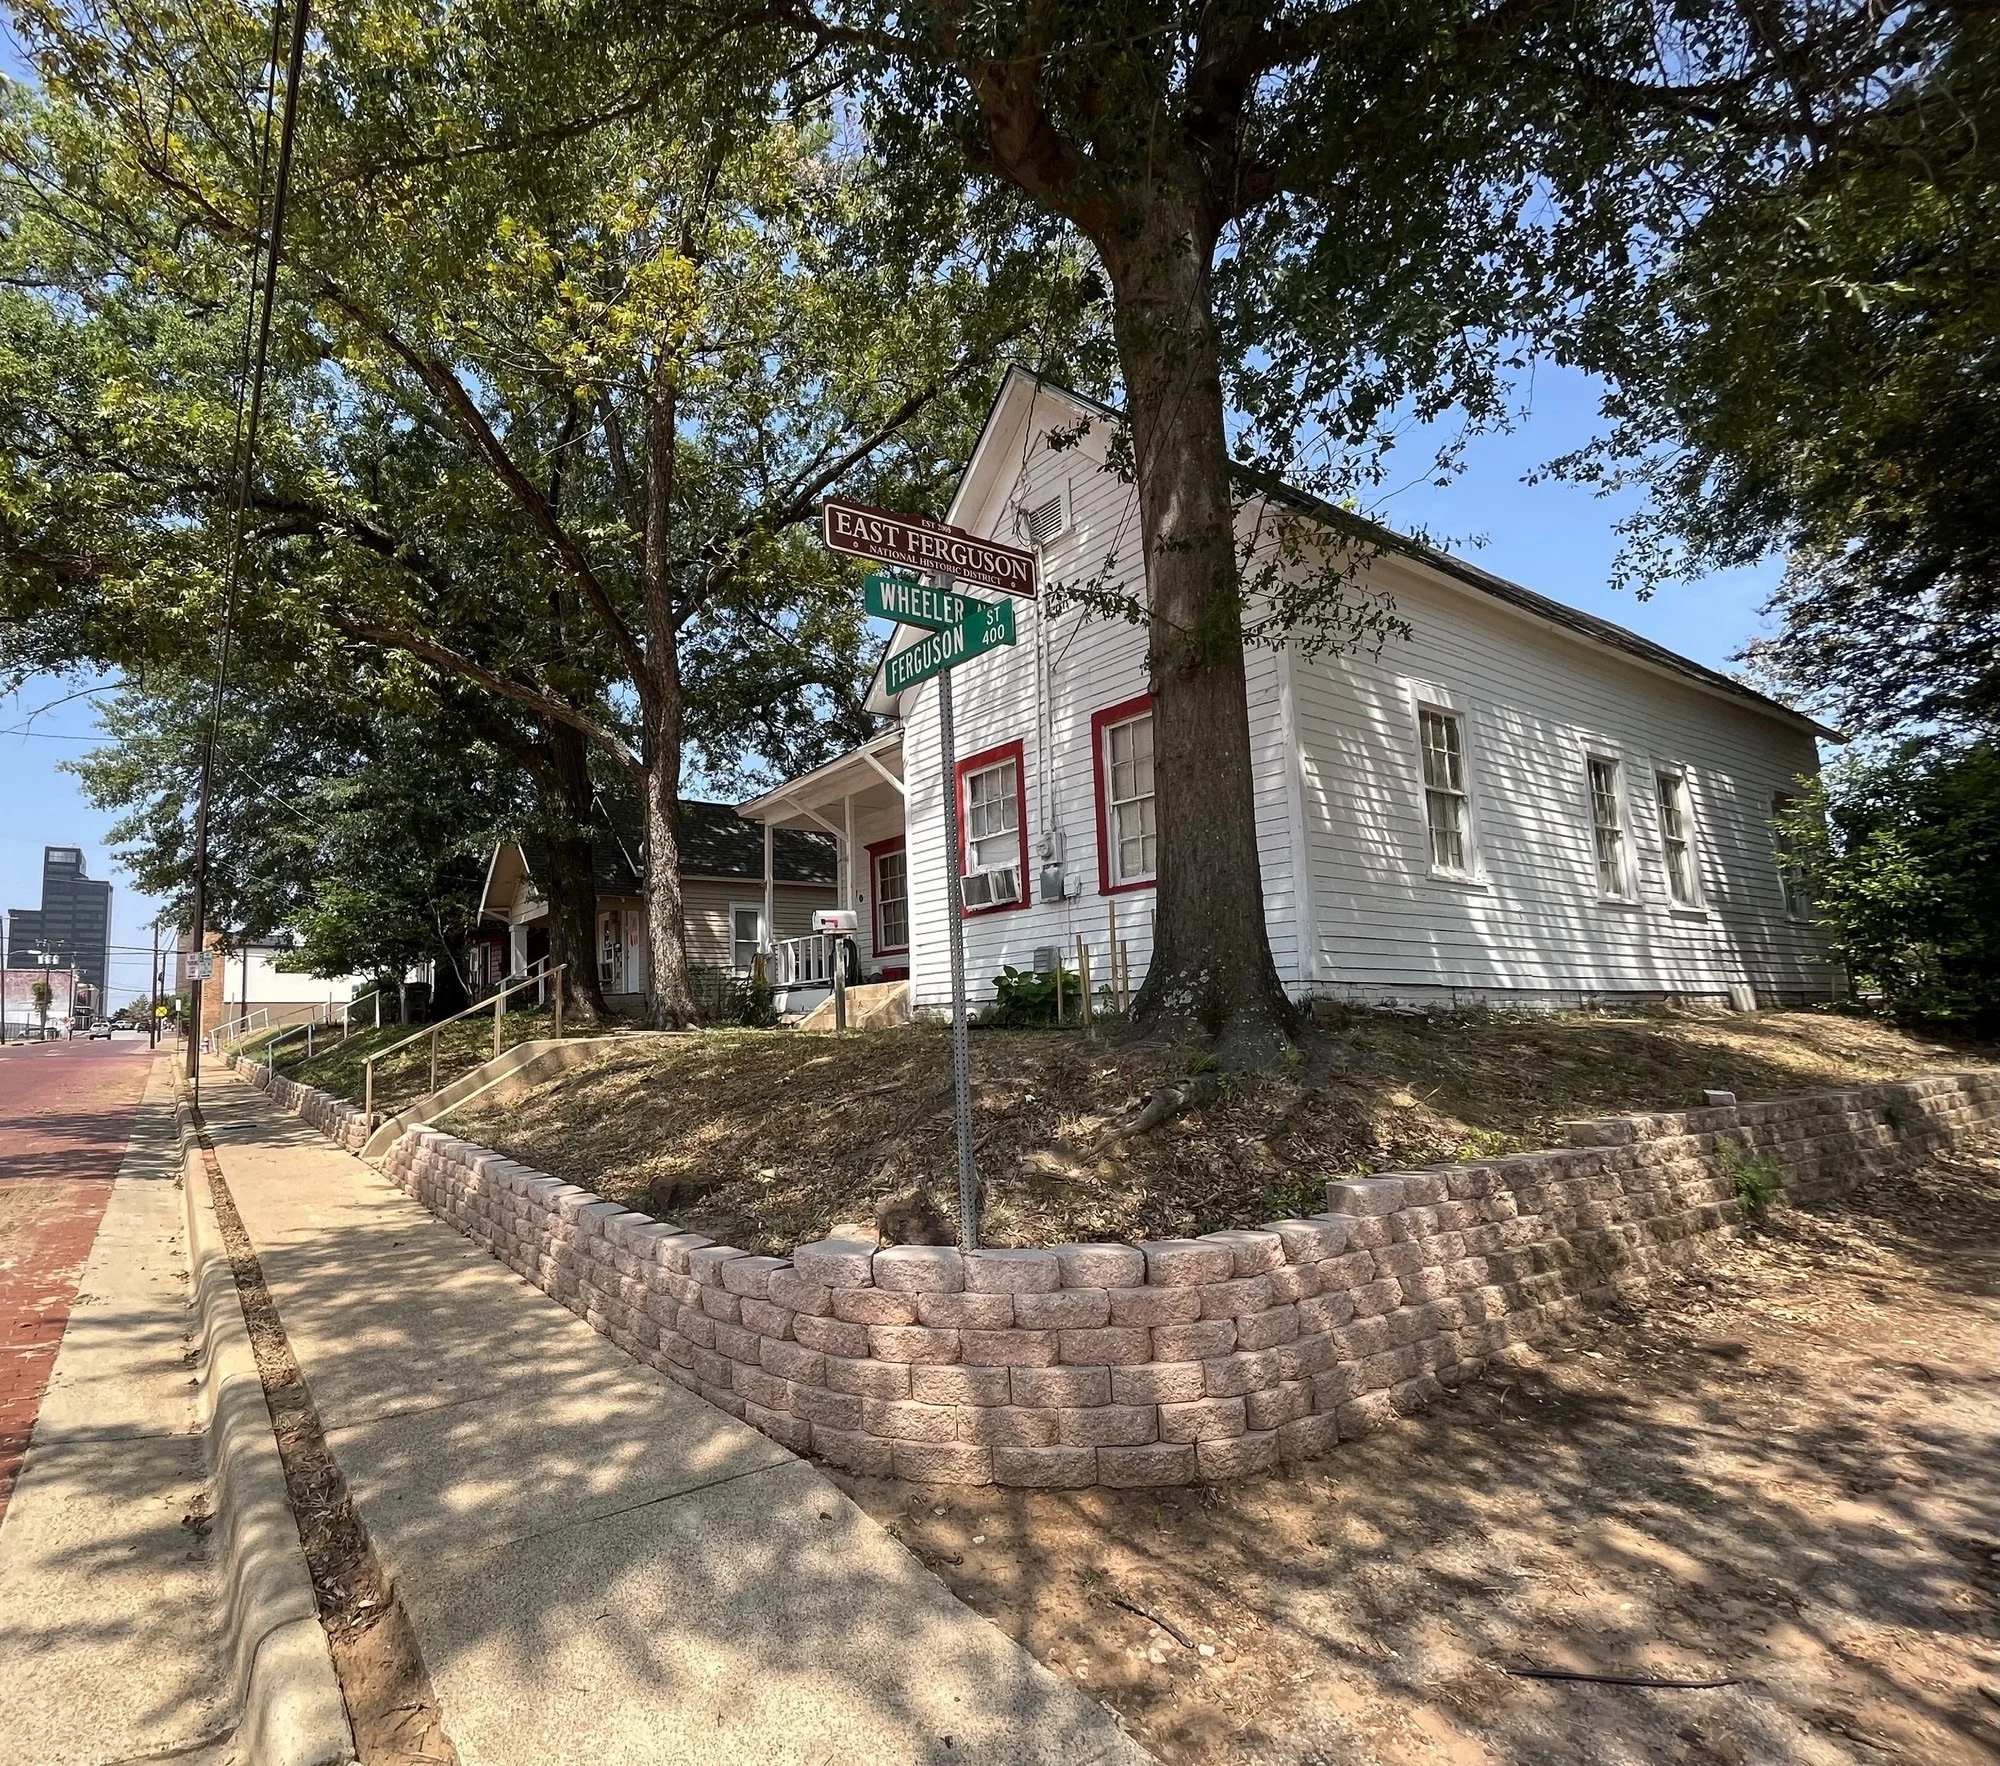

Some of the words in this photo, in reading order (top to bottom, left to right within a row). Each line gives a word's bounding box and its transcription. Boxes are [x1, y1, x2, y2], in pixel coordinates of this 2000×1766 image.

[921, 519, 936, 529] EST
[836, 511, 899, 548] EAST
[907, 531, 1028, 582] FERGUSON
[869, 544, 918, 564] NATIONAL
[919, 558, 962, 575] HISTORIC
[963, 568, 1002, 585] DISTRICT
[880, 582, 965, 624] WHEELER
[891, 624, 964, 687] FERGUSON
[986, 606, 1000, 625] ST
[982, 624, 1005, 645] 400
